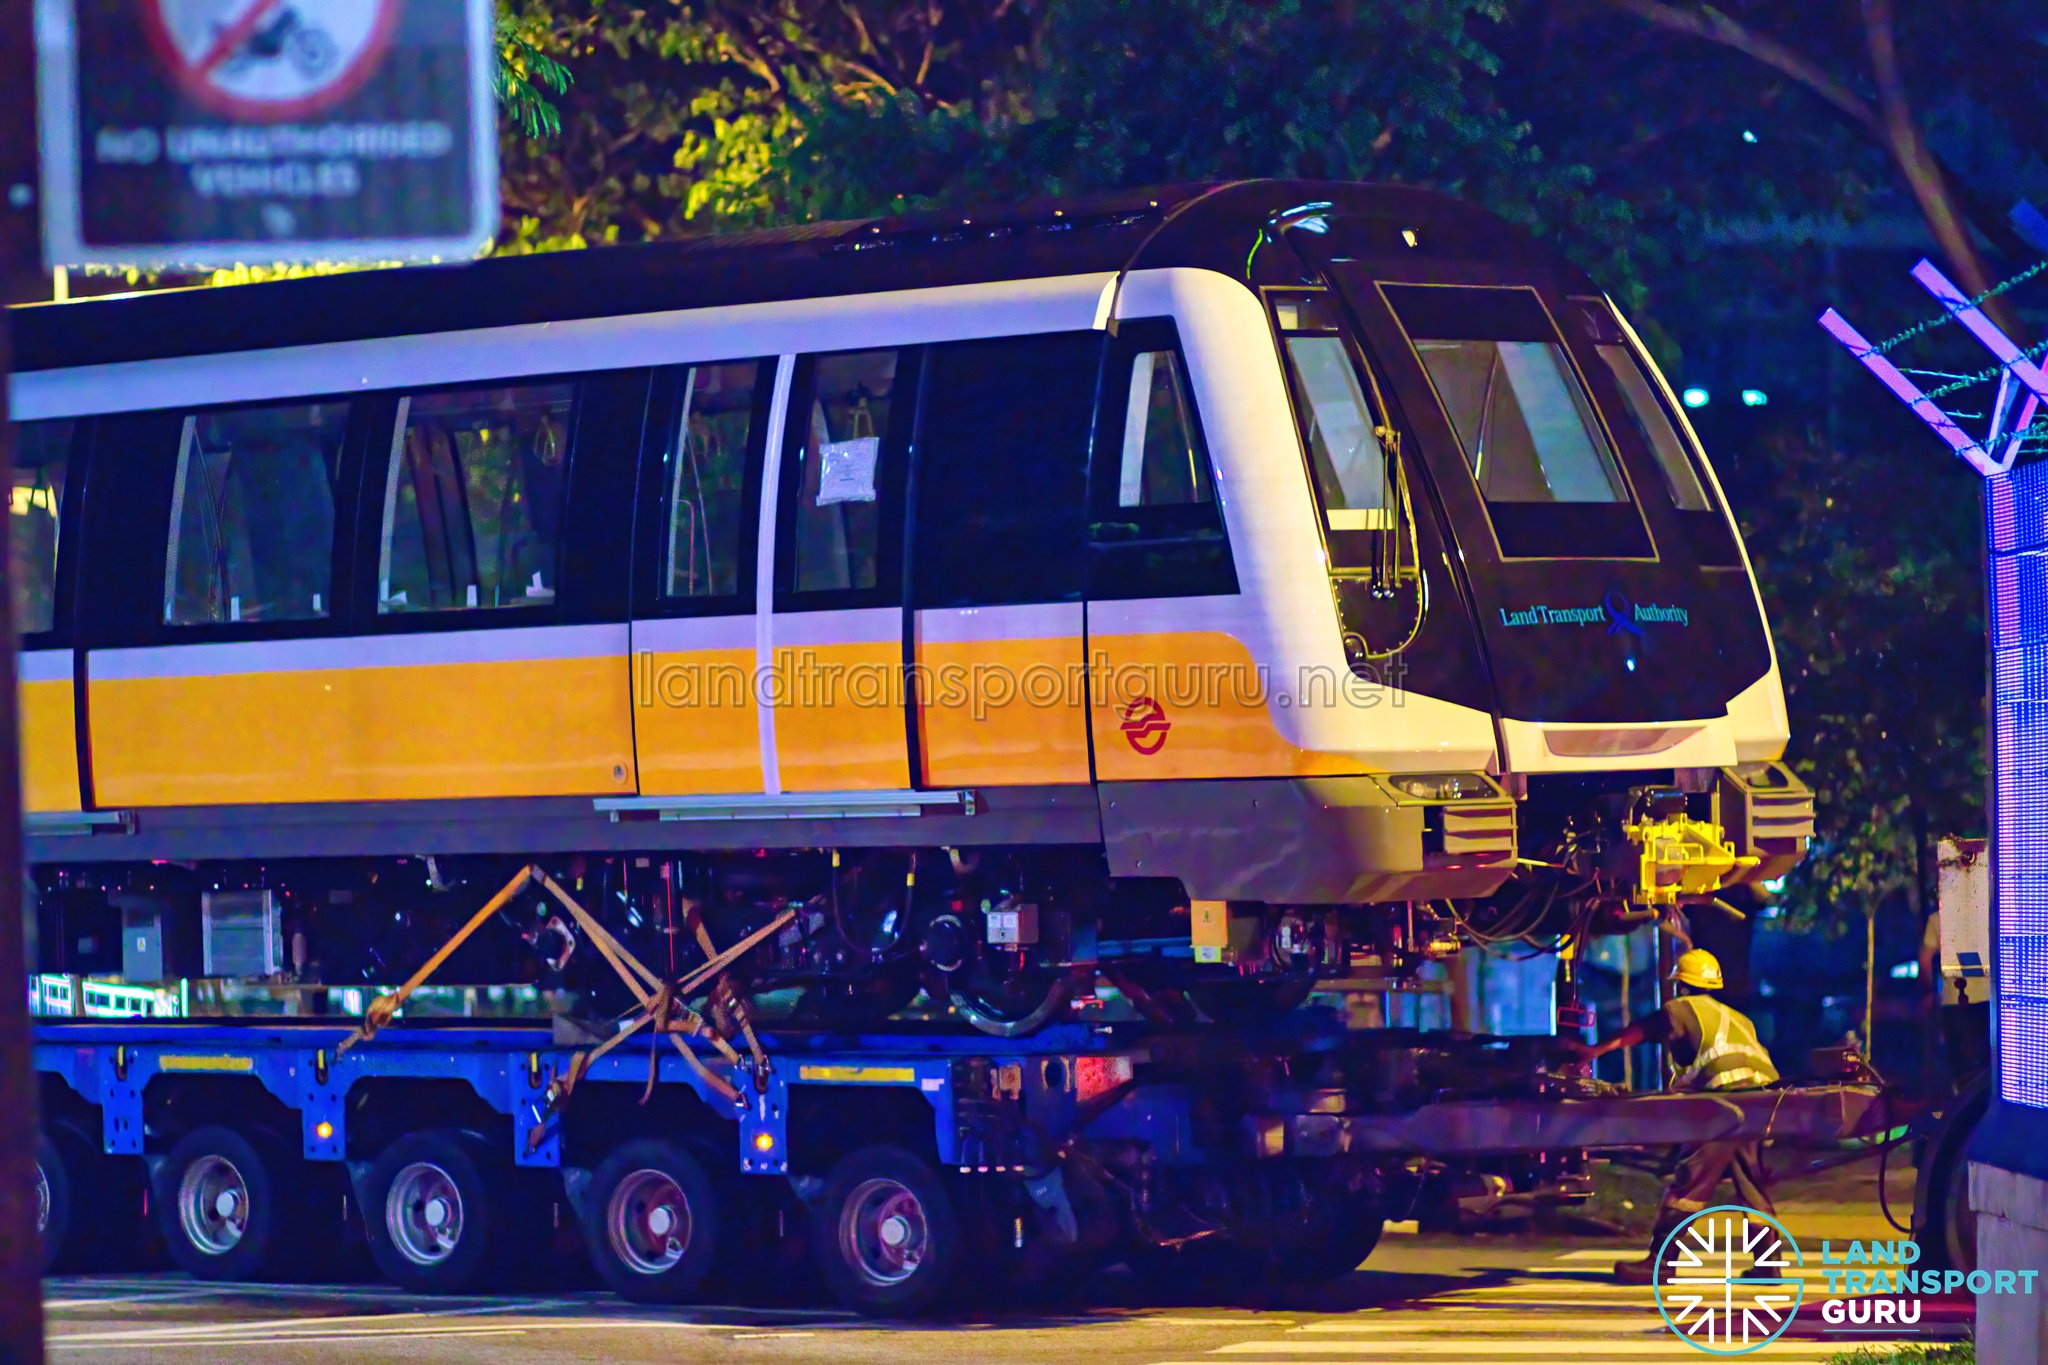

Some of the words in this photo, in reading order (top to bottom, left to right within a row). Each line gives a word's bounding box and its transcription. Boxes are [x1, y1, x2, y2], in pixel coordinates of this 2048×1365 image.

[96, 127, 160, 165] NO
[191, 161, 361, 196] VEHICLES
[1500, 605, 1538, 626] Land
[1537, 605, 1606, 627] Transport
[1634, 603, 1689, 626] Authority
